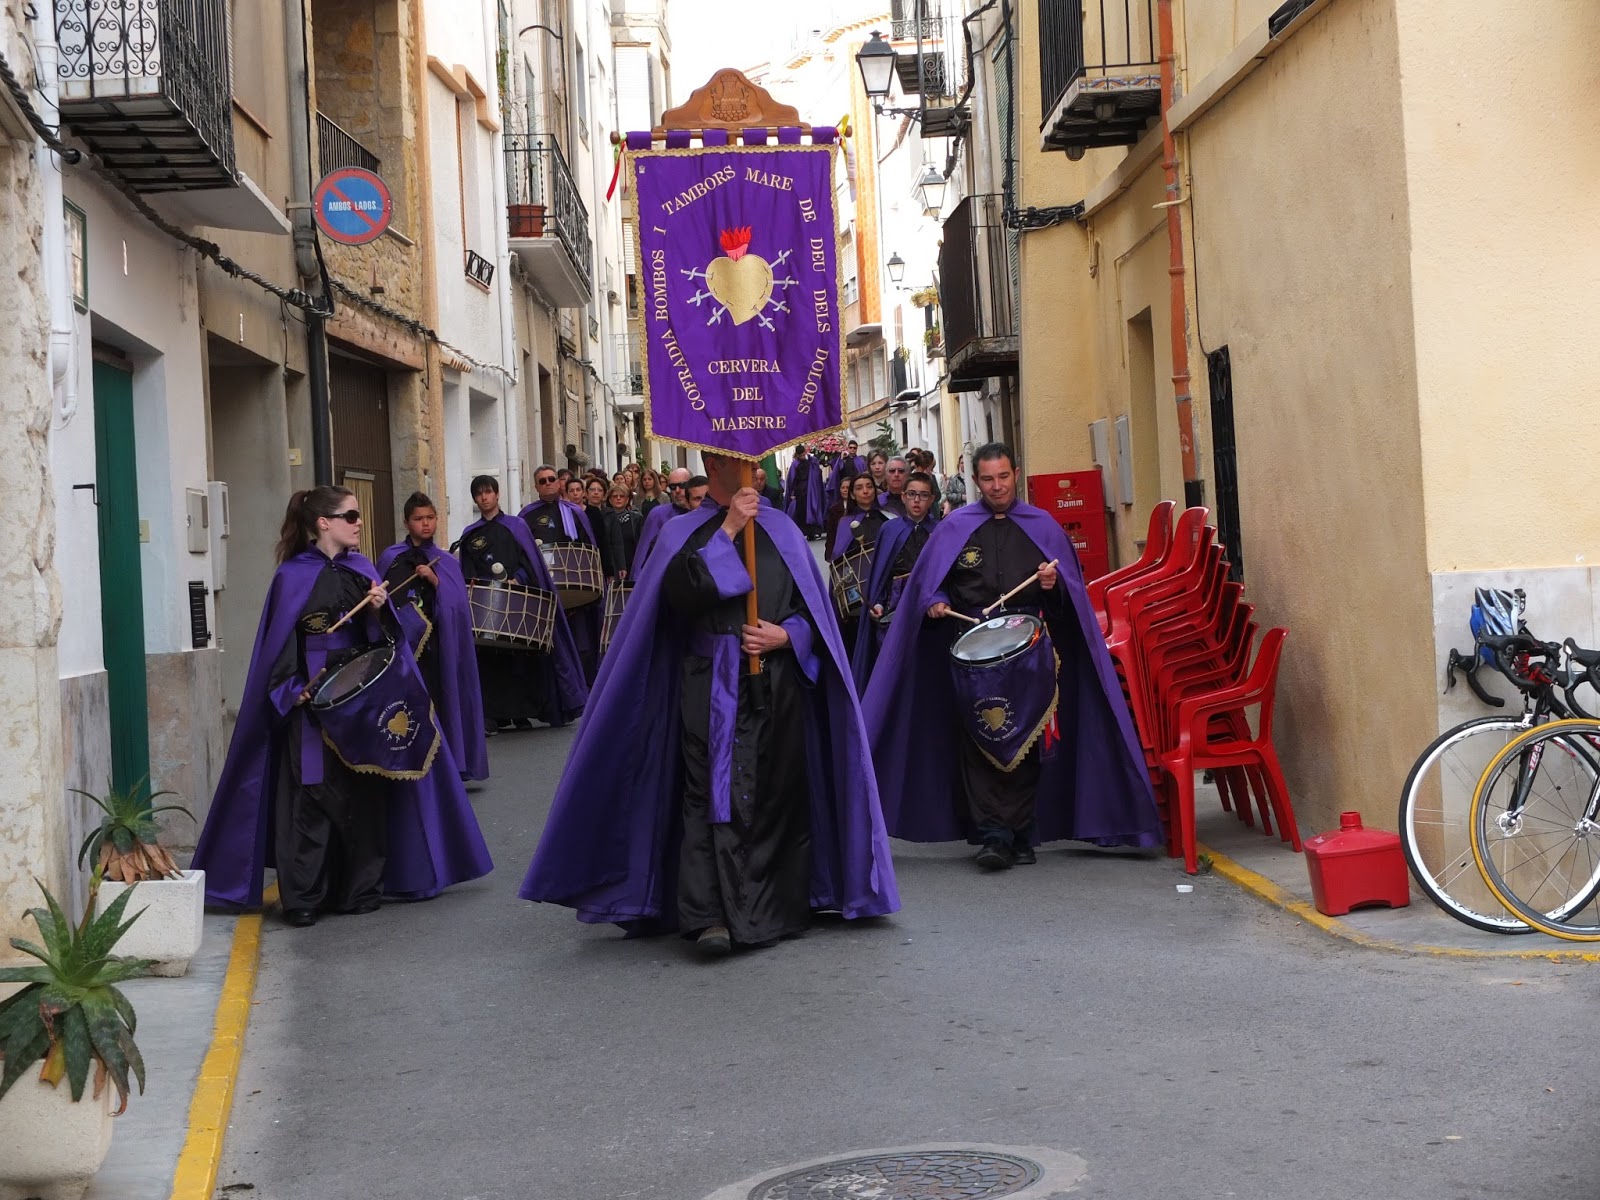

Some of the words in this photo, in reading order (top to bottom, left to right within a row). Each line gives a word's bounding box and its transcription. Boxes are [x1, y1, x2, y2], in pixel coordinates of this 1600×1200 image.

[662, 165, 735, 216] TAMBORS
[745, 168, 793, 191] MARE
[329, 201, 351, 212] AMBOS
[355, 200, 377, 211] LADOS
[799, 198, 817, 223] DE
[654, 226, 667, 236] I
[811, 238, 826, 272] DEU
[652, 250, 669, 322] BOMBOS
[814, 289, 831, 333] DELS
[662, 329, 706, 411] COFRADIA
[708, 358, 781, 374] CERVERA
[798, 348, 829, 415] DOLORS
[733, 387, 763, 401] DEL
[712, 415, 786, 431] MAESTRE
[1057, 499, 1083, 508] Damm
